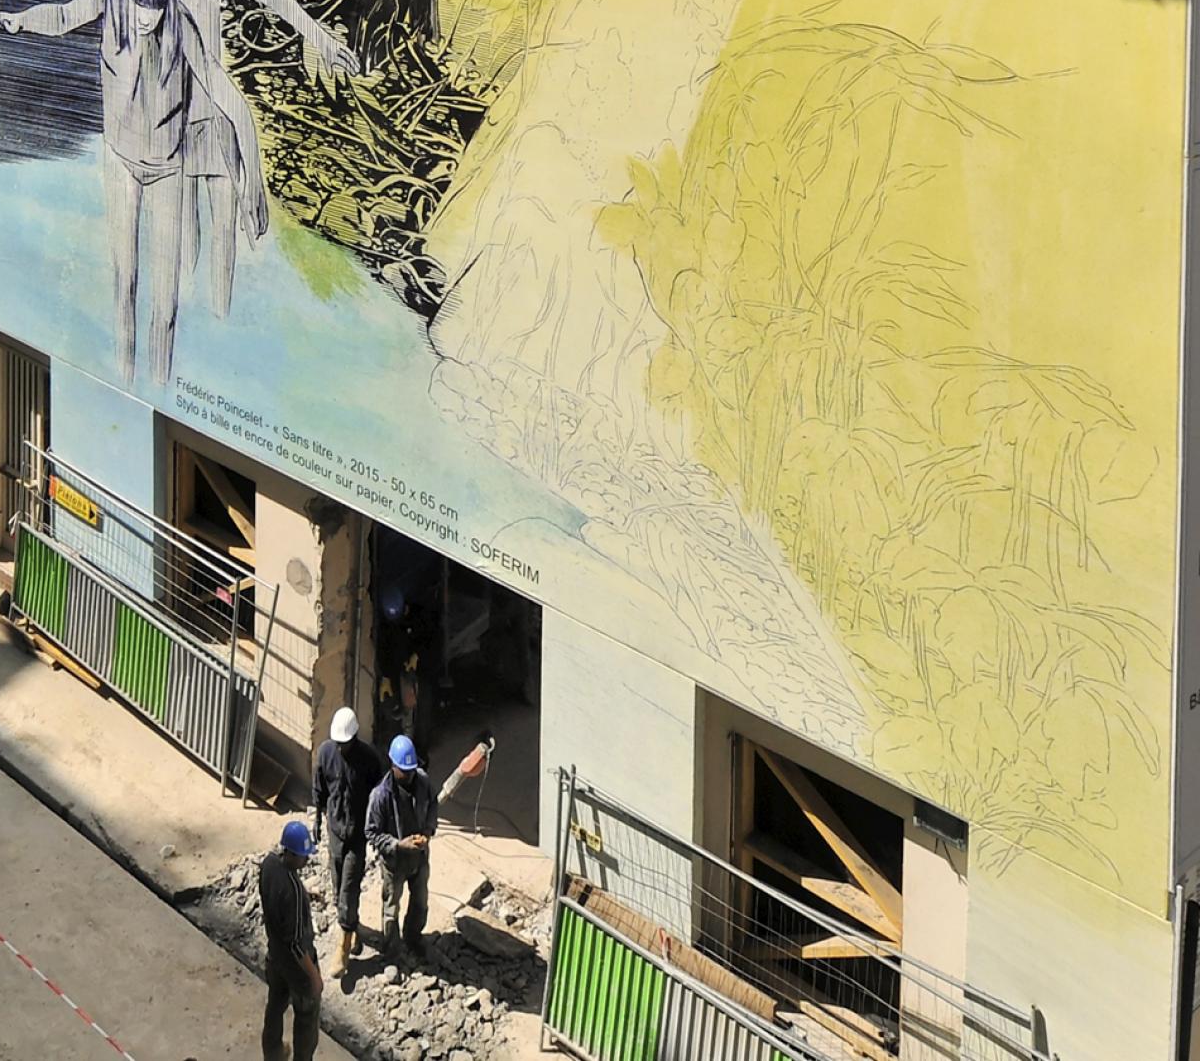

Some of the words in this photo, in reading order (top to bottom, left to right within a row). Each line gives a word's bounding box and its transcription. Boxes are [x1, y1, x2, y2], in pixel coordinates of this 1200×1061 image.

[176, 377, 215, 405] Frédéric
[217, 396, 263, 427] Poincelet
[282, 426, 310, 449] Sans
[312, 441, 333, 460] titre
[350, 458, 380, 483] 2015
[391, 477, 406, 495] 50
[409, 488, 417, 501] x
[420, 491, 436, 510] 65
[439, 503, 458, 521] cm
[176, 394, 199, 415] Stylo
[201, 407, 208, 420] à
[211, 411, 230, 431] bille
[232, 424, 242, 437] et
[245, 430, 274, 451] encre
[276, 444, 289, 459] de
[292, 453, 332, 480] couleur
[335, 474, 353, 490] sur
[399, 502, 459, 544] Copyright
[470, 537, 539, 584] SOFERIM
